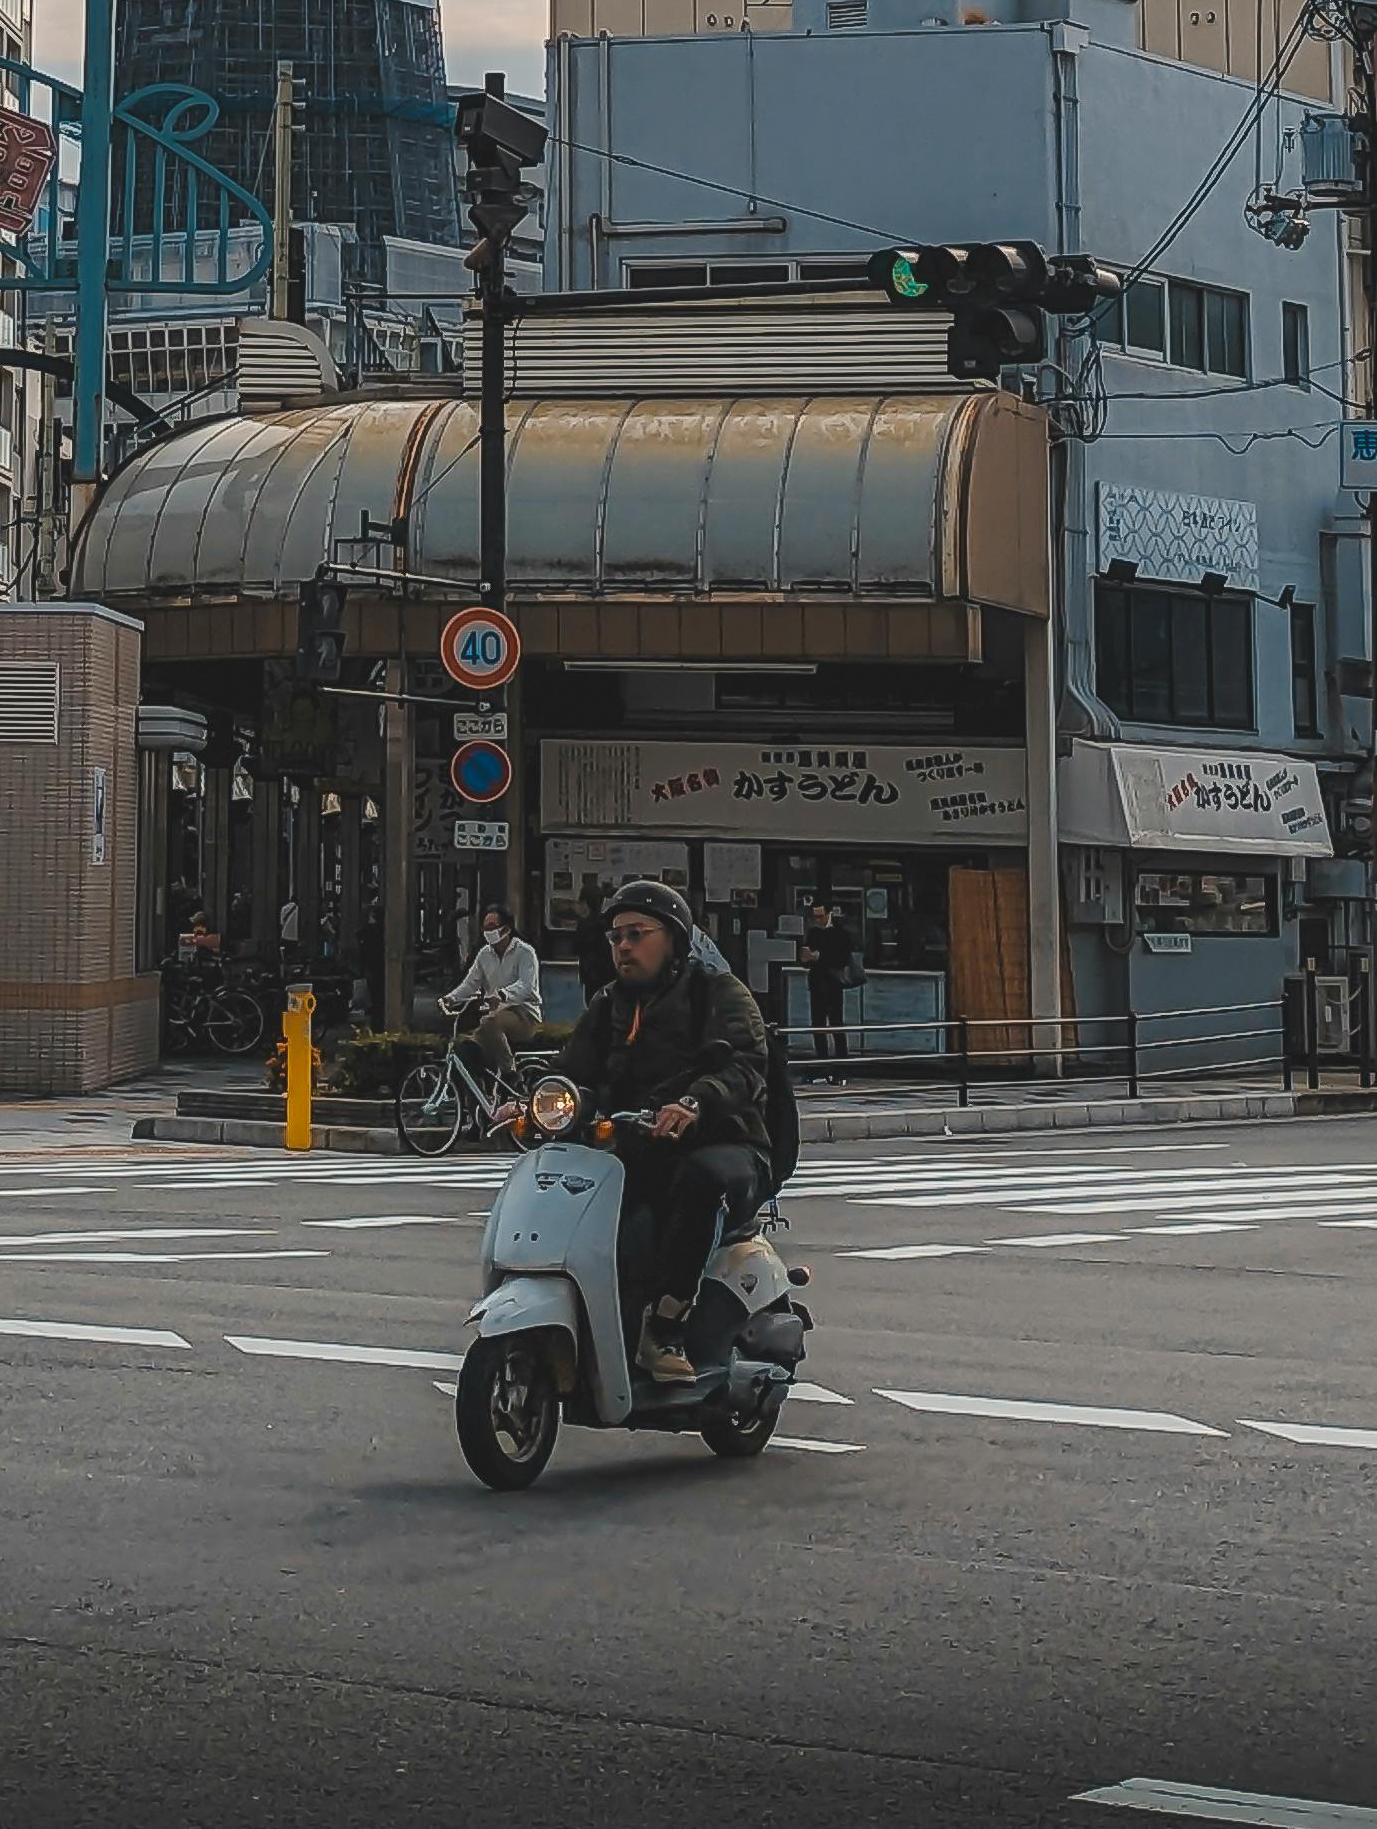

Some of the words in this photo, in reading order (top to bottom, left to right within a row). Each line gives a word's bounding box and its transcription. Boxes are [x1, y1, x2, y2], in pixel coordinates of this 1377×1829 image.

[460, 630, 502, 666] 40
[733, 770, 899, 805] かすうどん
[1194, 781, 1272, 813] かすうどん
